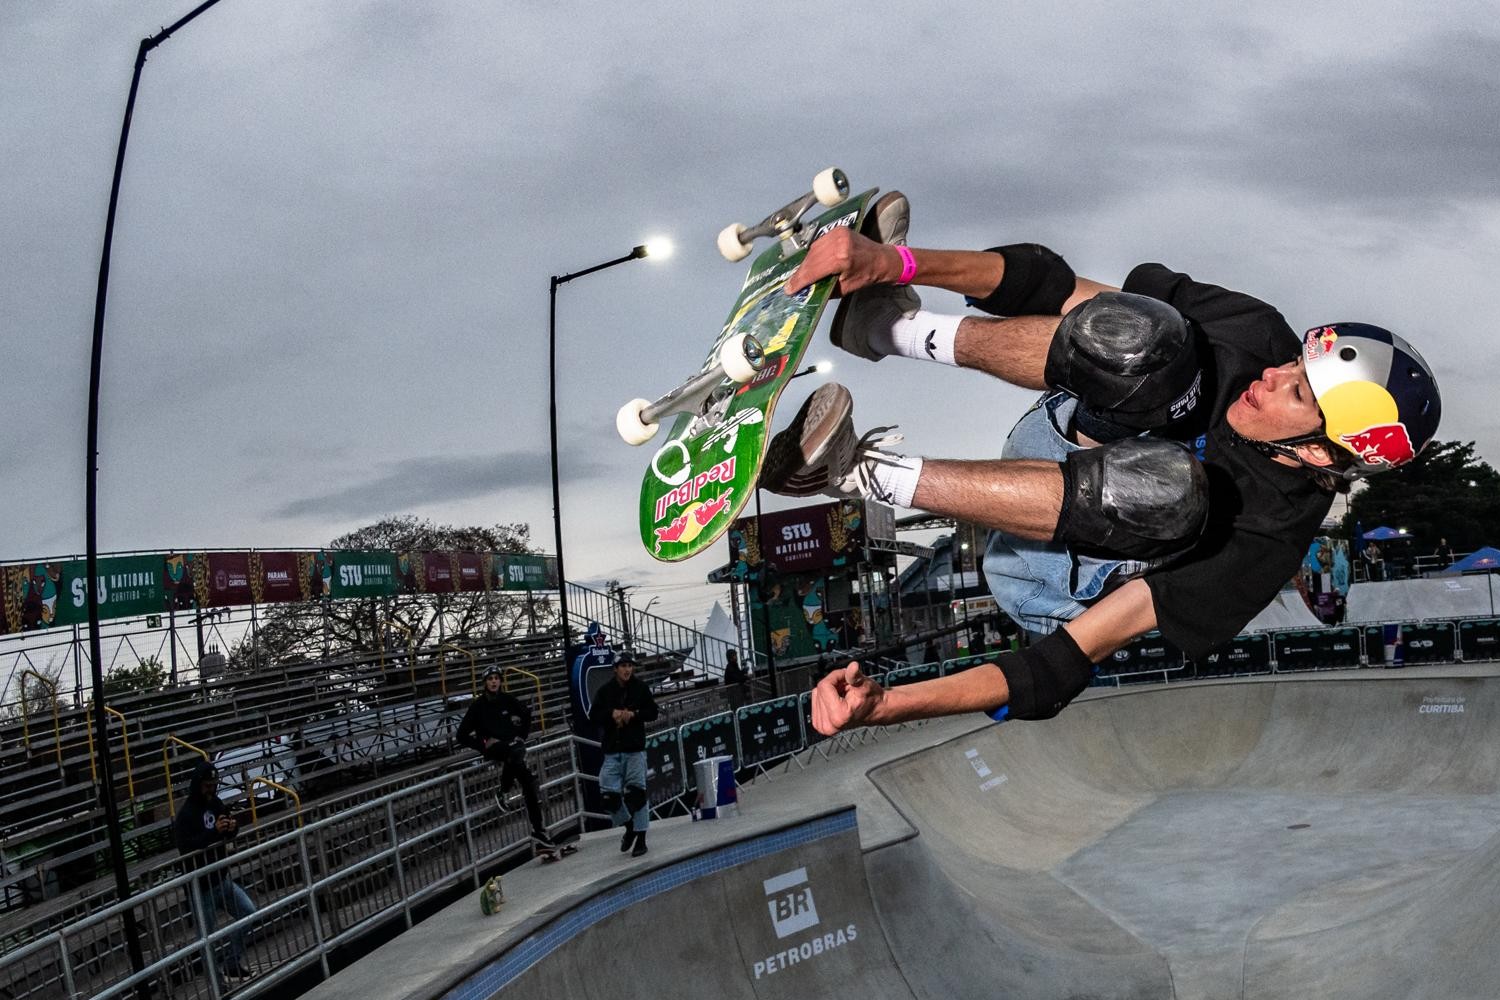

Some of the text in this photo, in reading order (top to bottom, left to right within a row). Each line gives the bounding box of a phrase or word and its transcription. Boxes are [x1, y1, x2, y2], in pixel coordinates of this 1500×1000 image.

[1170, 395, 1189, 412] PADS
[782, 523, 812, 541] STU
[776, 539, 820, 554] NATIONAL
[267, 570, 288, 580] PARANÁ
[340, 564, 362, 586] STU
[364, 564, 391, 576] NATIONAL
[509, 565, 524, 582] STU
[111, 571, 155, 589] NATIONAL
[111, 590, 140, 603] CURITIBA
[1419, 704, 1464, 713] CURITIBA
[753, 924, 858, 980] PETROBRAS
